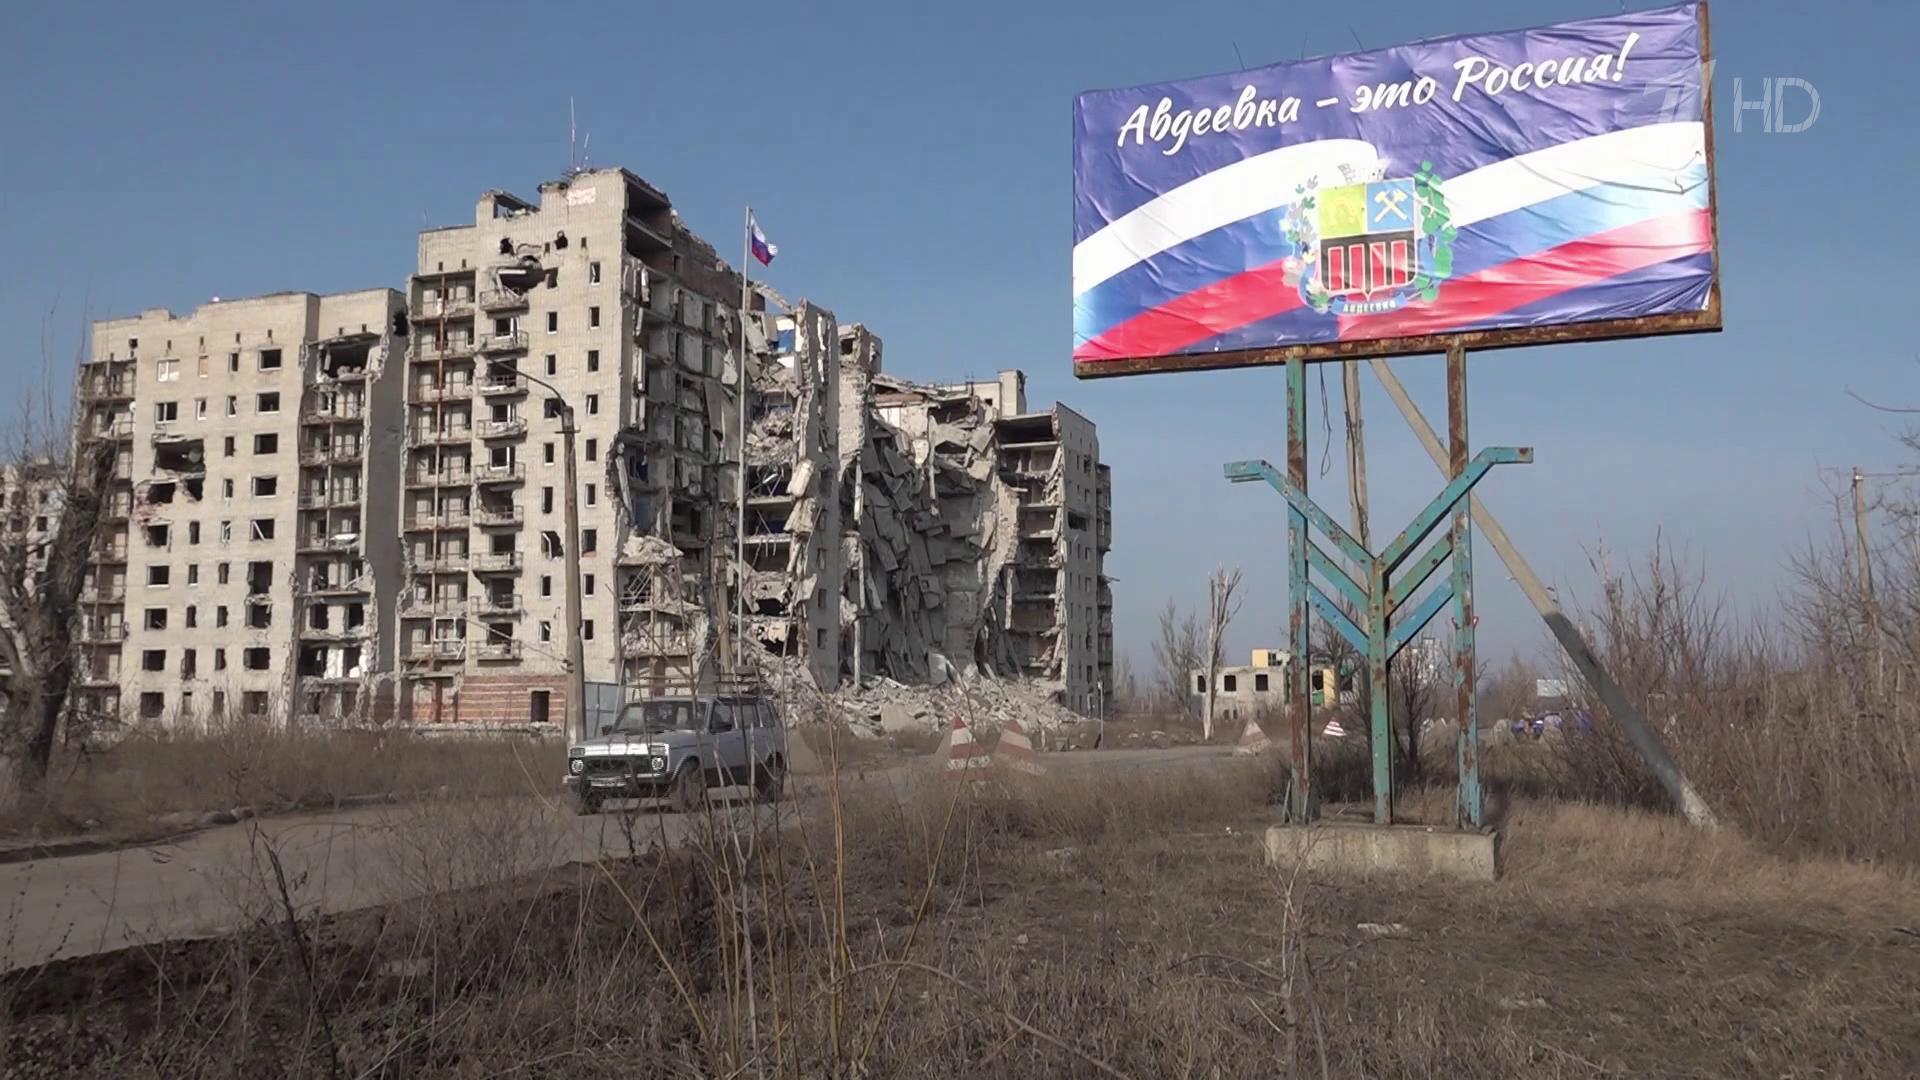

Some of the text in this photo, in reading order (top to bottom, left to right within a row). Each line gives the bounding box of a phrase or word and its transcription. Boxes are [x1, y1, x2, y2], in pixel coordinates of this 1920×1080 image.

[1117, 85, 1301, 156] Авдеевка
[1350, 76, 1436, 112] это
[1452, 32, 1640, 102] Россия!
